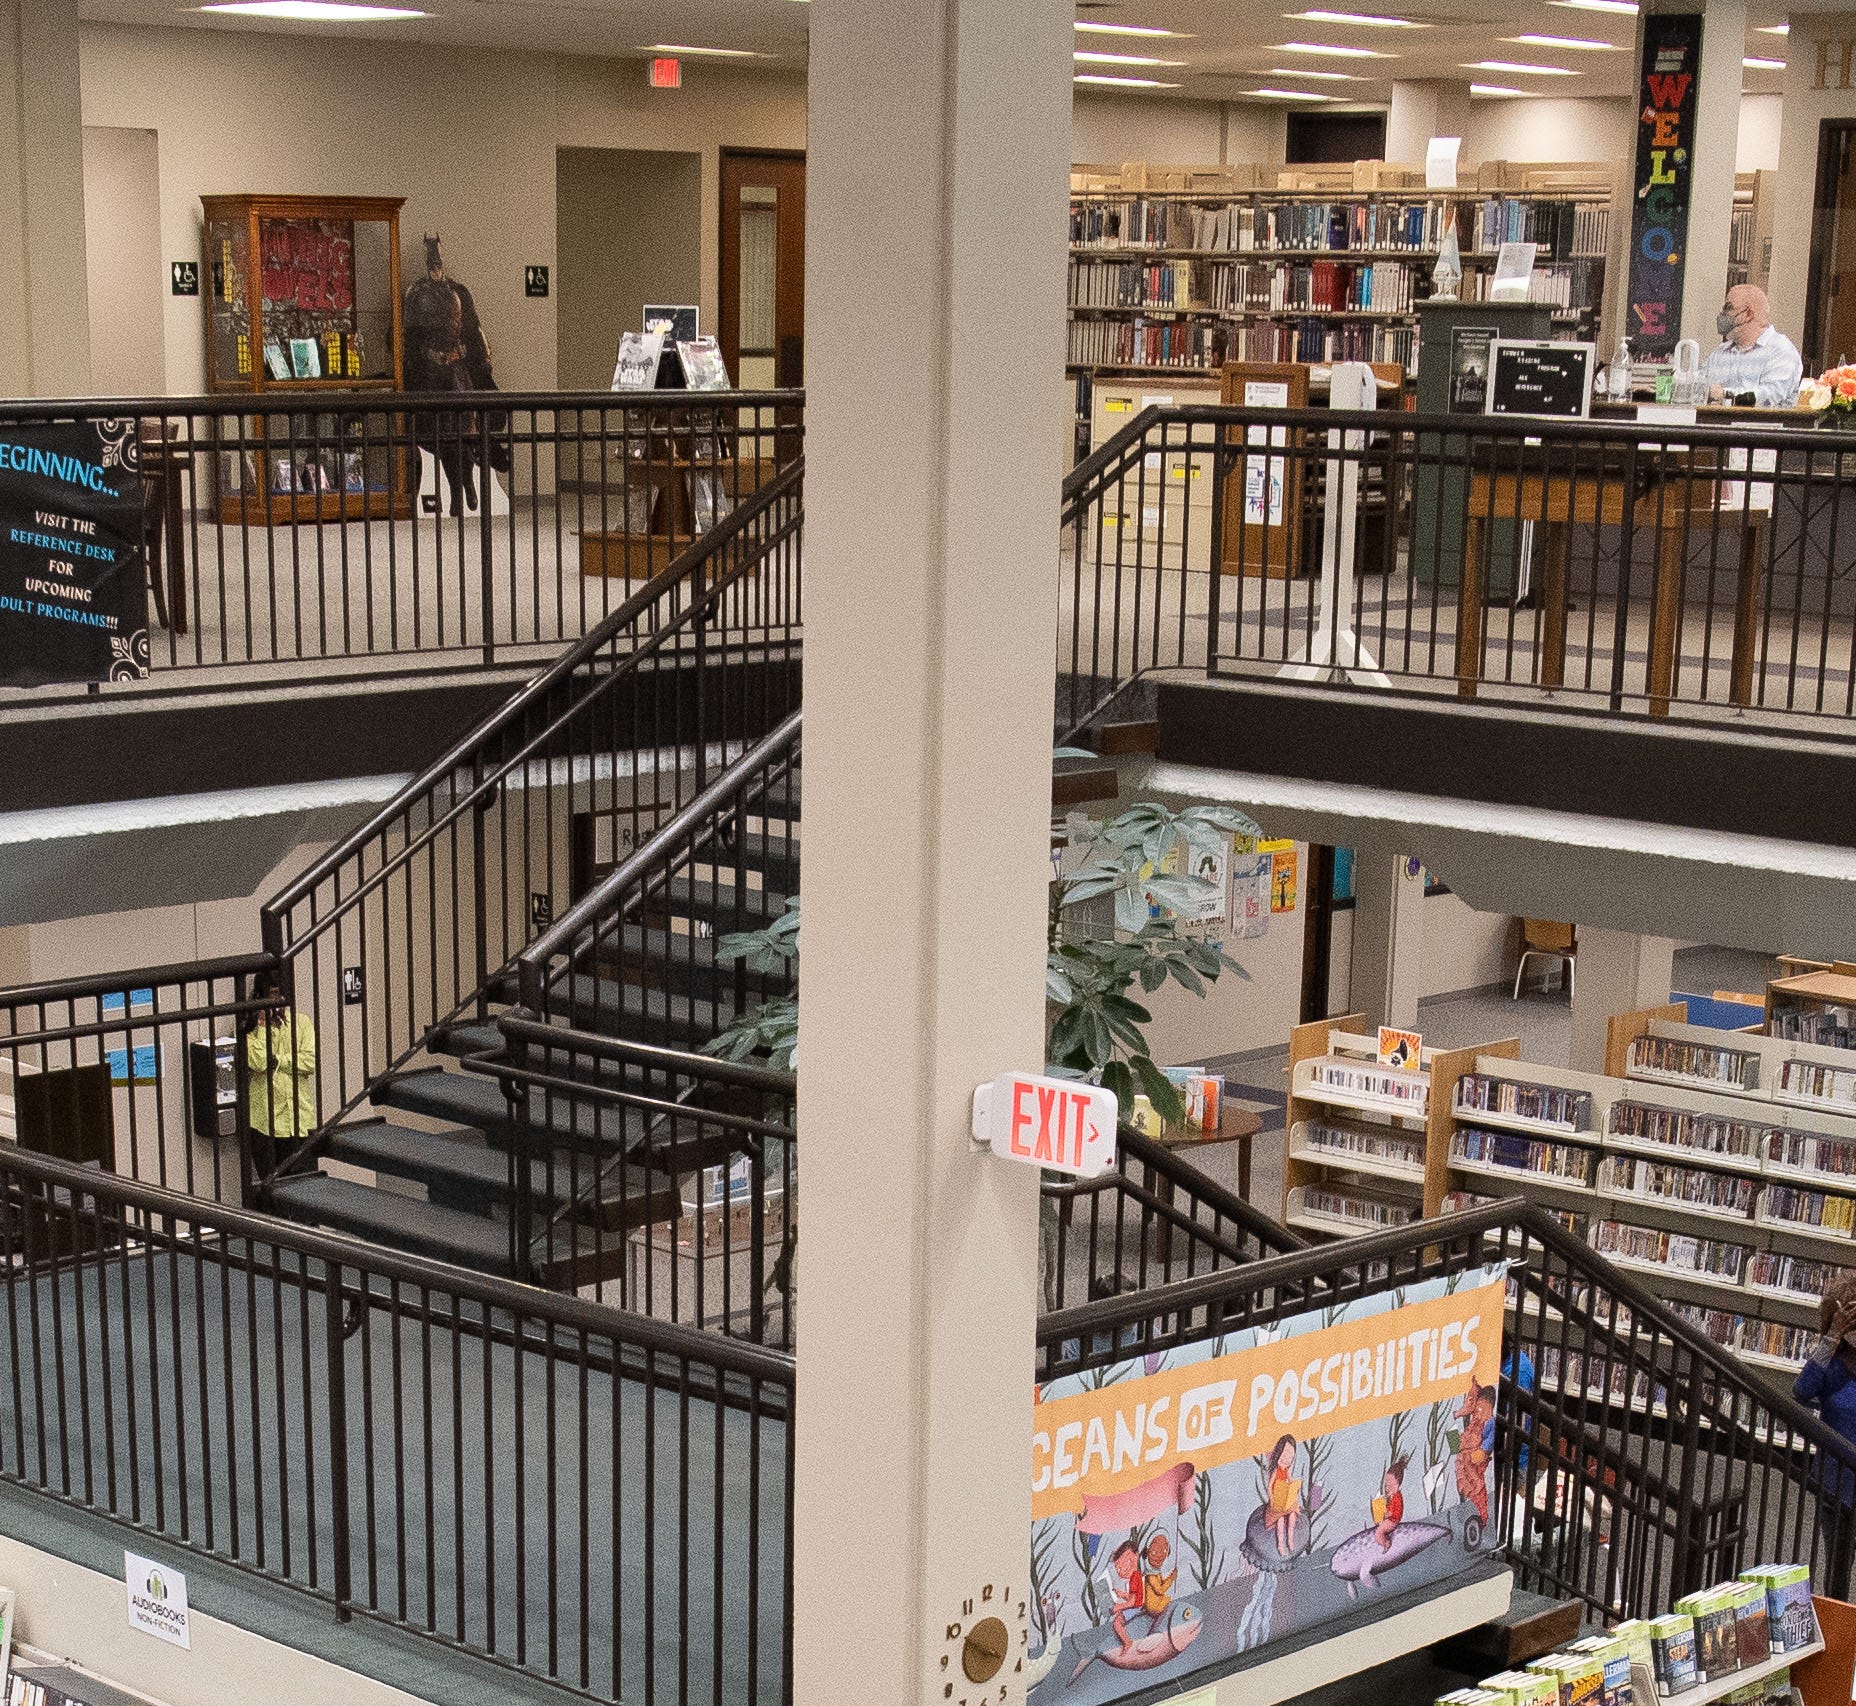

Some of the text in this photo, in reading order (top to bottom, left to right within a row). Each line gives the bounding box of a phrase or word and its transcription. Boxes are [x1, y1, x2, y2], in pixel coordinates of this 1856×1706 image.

[34, 510, 97, 536] VISIT THE
[10, 528, 116, 563] REFERENCE DESK
[48, 559, 74, 577] FOR
[25, 576, 93, 602] UPCOMING
[37, 601, 120, 630] PROGRAMS!!!
[1010, 1081, 1091, 1168] EXIT
[1184, 1402, 1230, 1442] OF
[982, 1583, 993, 1602] 12
[1004, 1586, 1010, 1602] 1
[132, 1595, 186, 1626] AUDIOBOOKS
[962, 1599, 974, 1616] 11
[1018, 1601, 1026, 1619] 2
[137, 1612, 181, 1636] NON-FICTION
[946, 1622, 961, 1641] 10
[1021, 1629, 1028, 1645] 3
[940, 1654, 949, 1672] 9
[1014, 1657, 1022, 1673] 4
[944, 1683, 953, 1699] 8
[1000, 1685, 1007, 1702] 5
